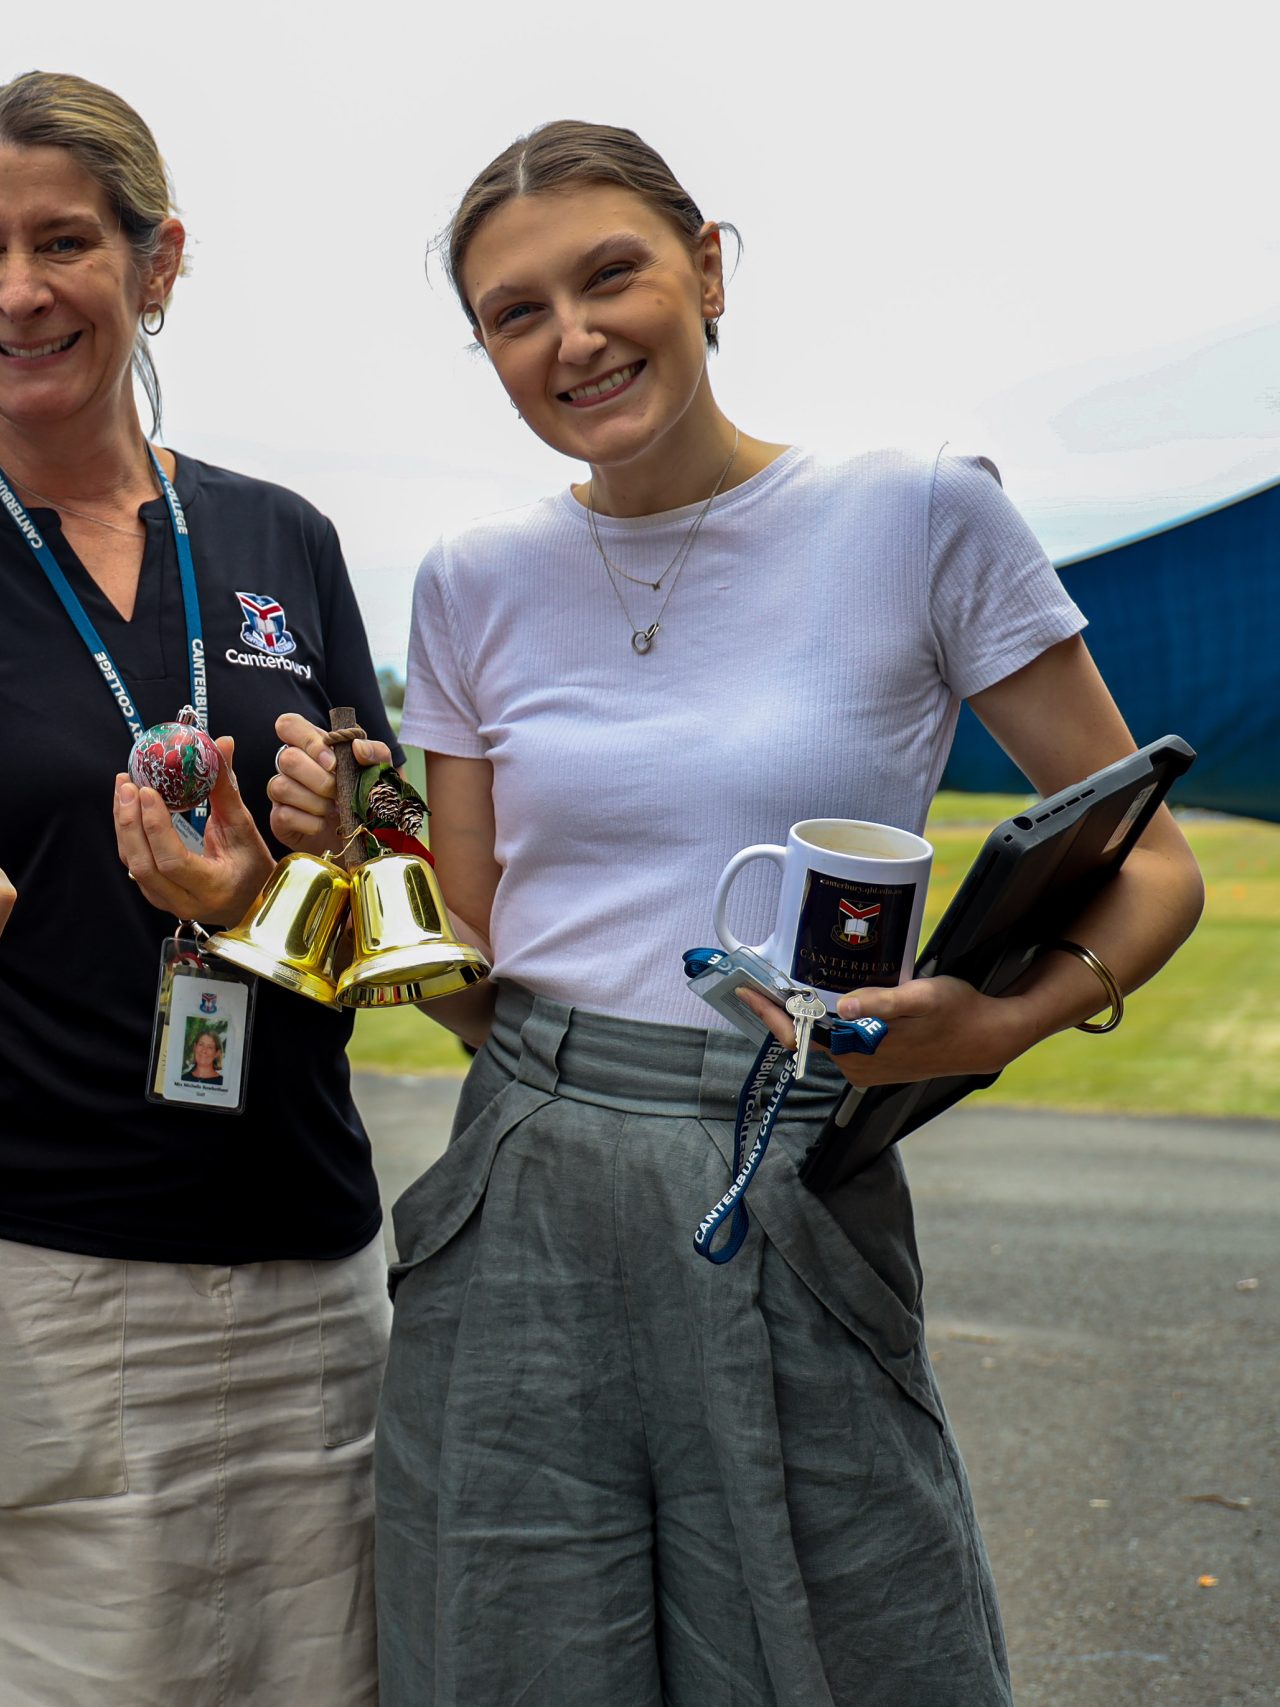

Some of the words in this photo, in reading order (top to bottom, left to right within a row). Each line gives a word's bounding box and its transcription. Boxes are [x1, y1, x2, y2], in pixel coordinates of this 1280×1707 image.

[164, 480, 188, 535] COLLEGE
[93, 651, 135, 718] COLLEGE
[225, 648, 312, 679] Canterbury
[799, 947, 897, 973] CANTERBURY
[694, 1139, 761, 1243] CANTERBURY
[760, 1059, 794, 1136] COLLEGE
